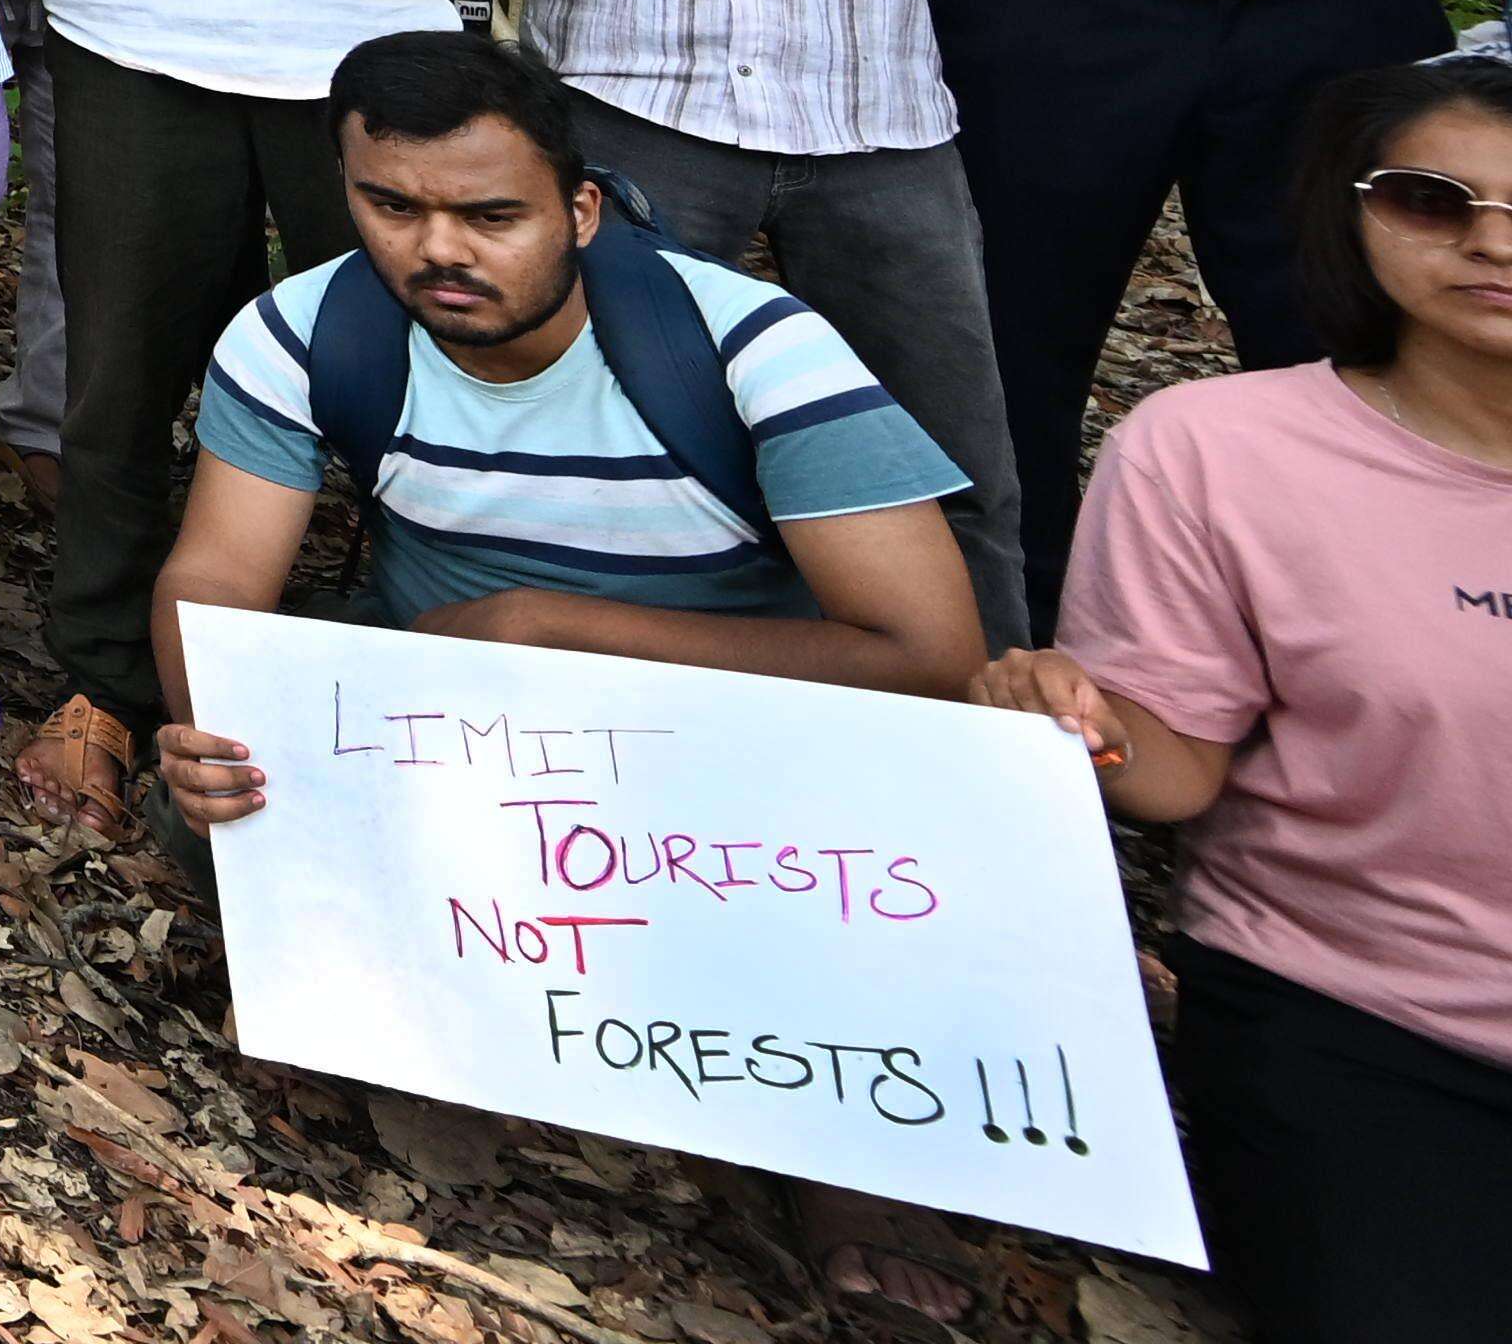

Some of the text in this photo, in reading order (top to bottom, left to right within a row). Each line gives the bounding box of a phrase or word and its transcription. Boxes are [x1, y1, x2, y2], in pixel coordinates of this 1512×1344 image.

[333, 680, 674, 784] LIMIT
[499, 800, 939, 924] TOURISTS
[448, 898, 649, 975] NOT
